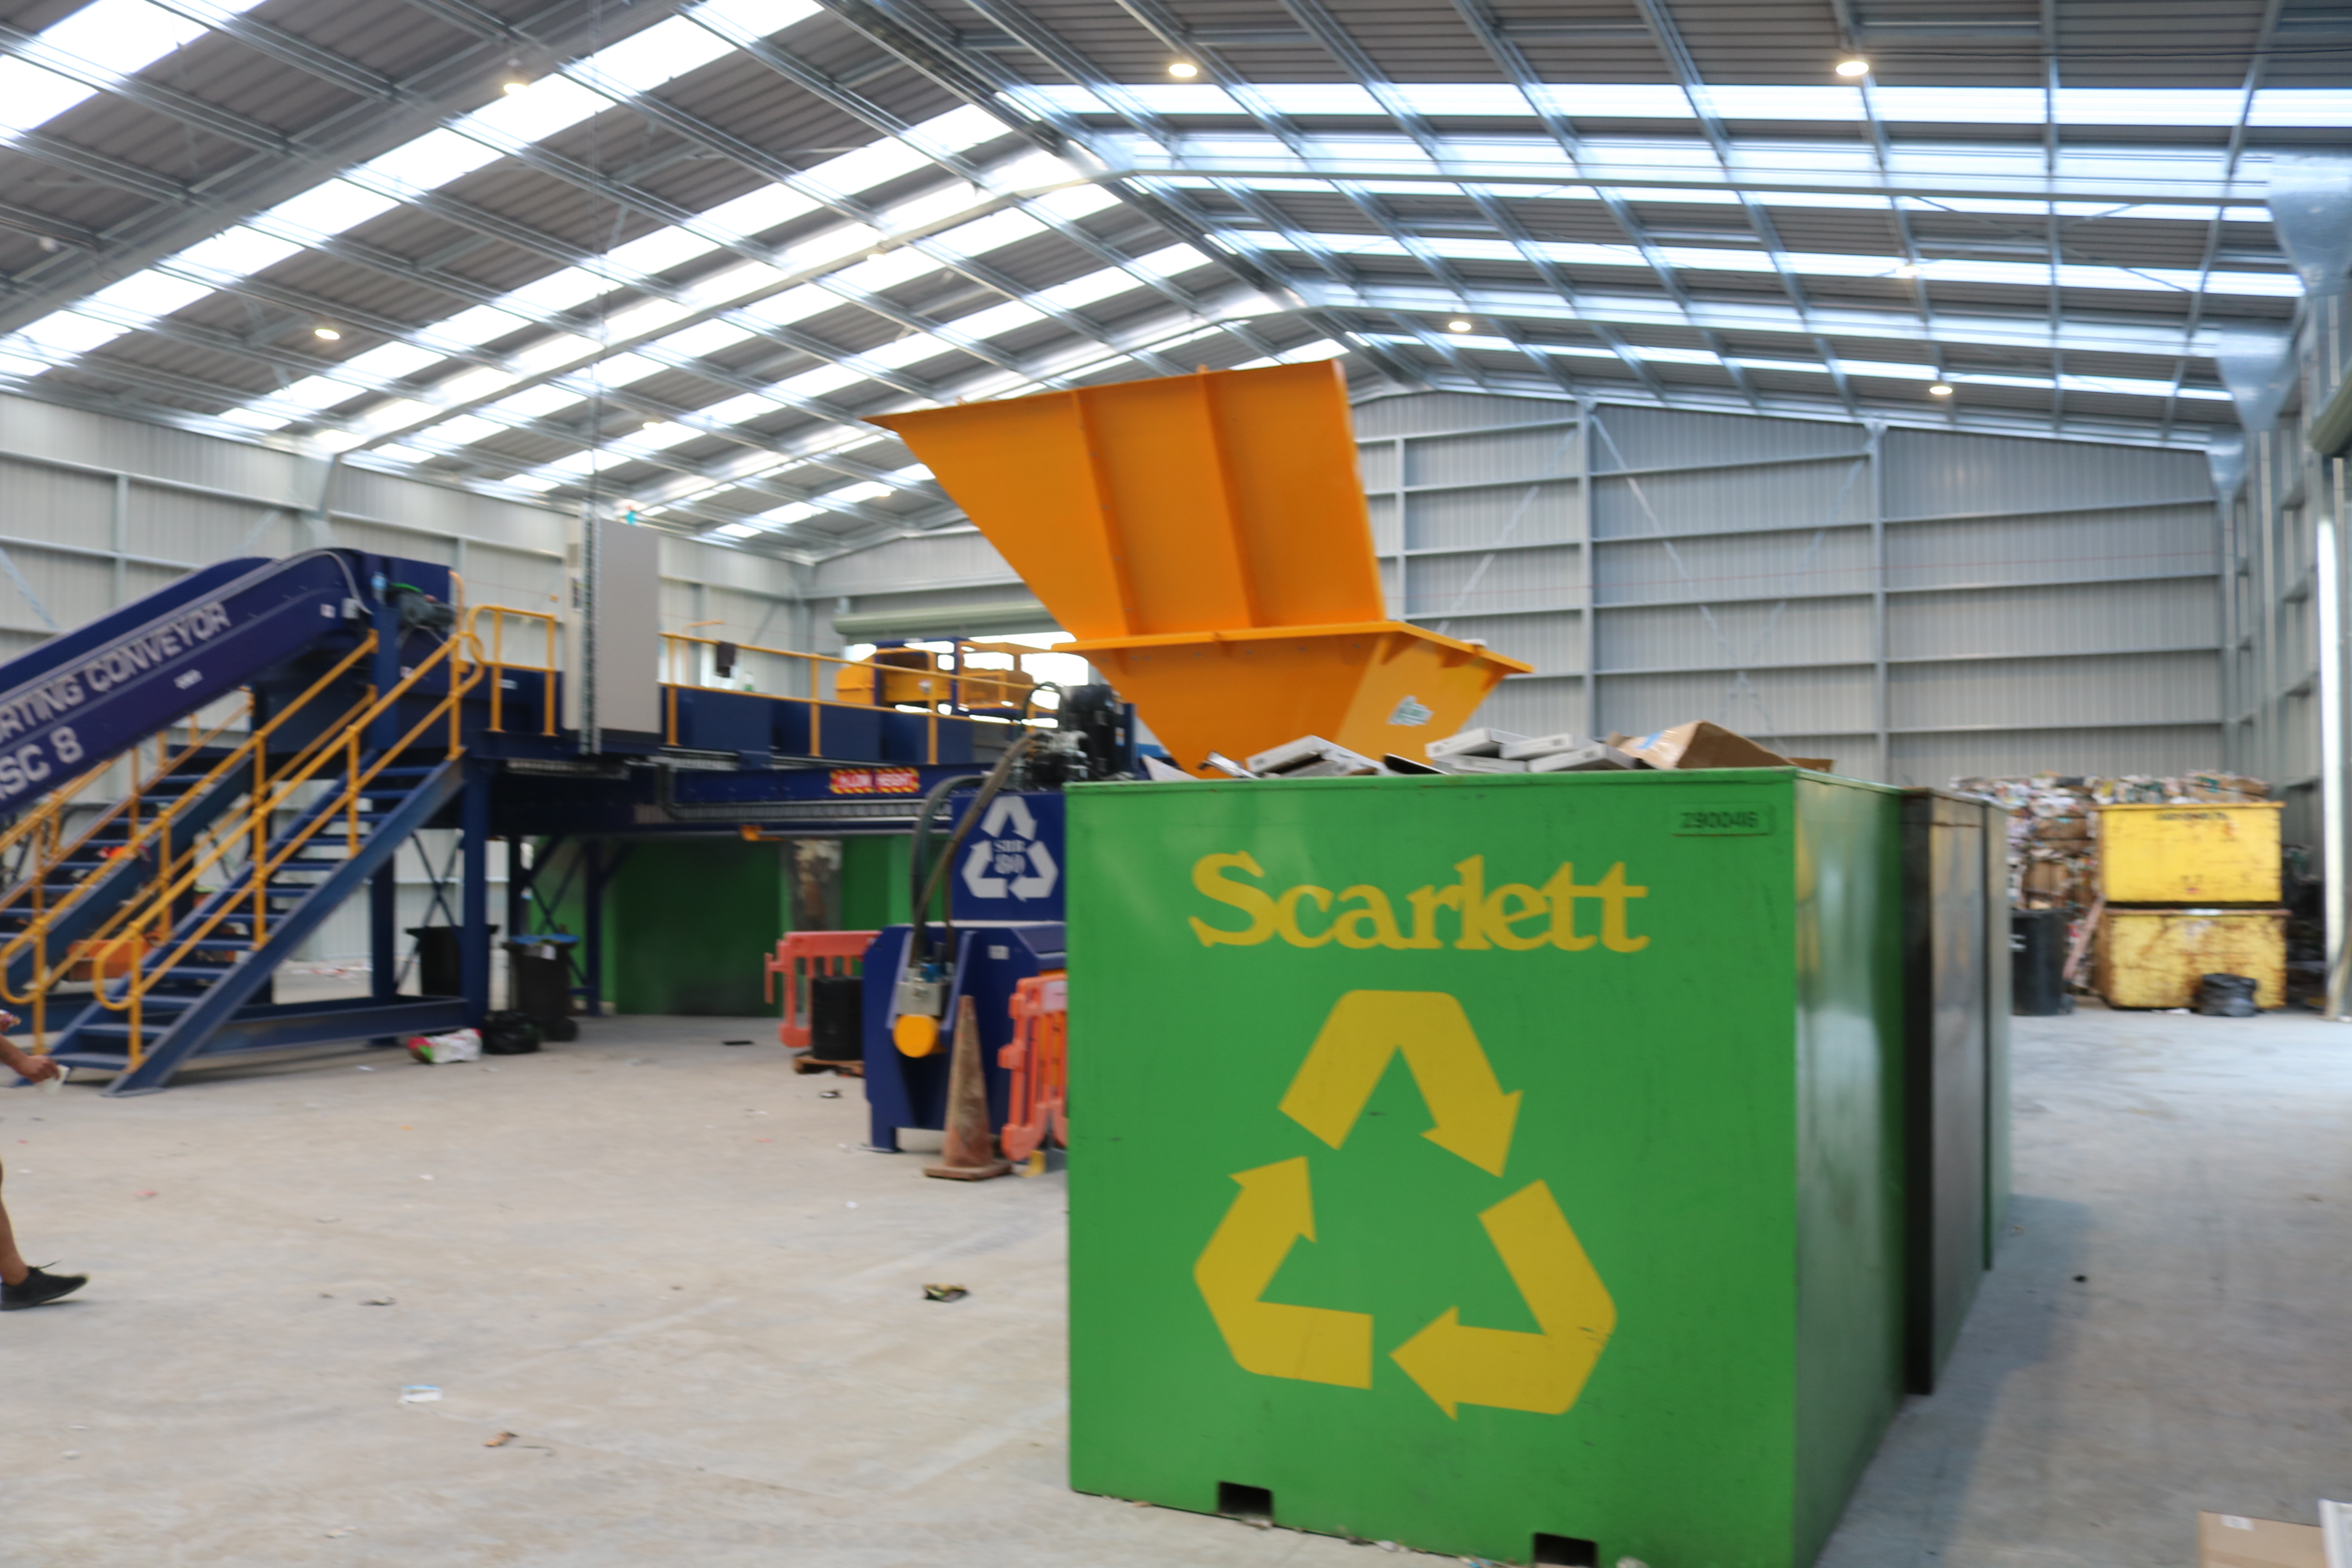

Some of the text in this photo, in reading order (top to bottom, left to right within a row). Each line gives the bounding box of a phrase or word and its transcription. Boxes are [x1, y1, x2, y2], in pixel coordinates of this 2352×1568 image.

[0, 601, 231, 744] RTING CONVEYOR
[0, 726, 84, 800] SC 8
[1187, 850, 1650, 953] Scarlett
